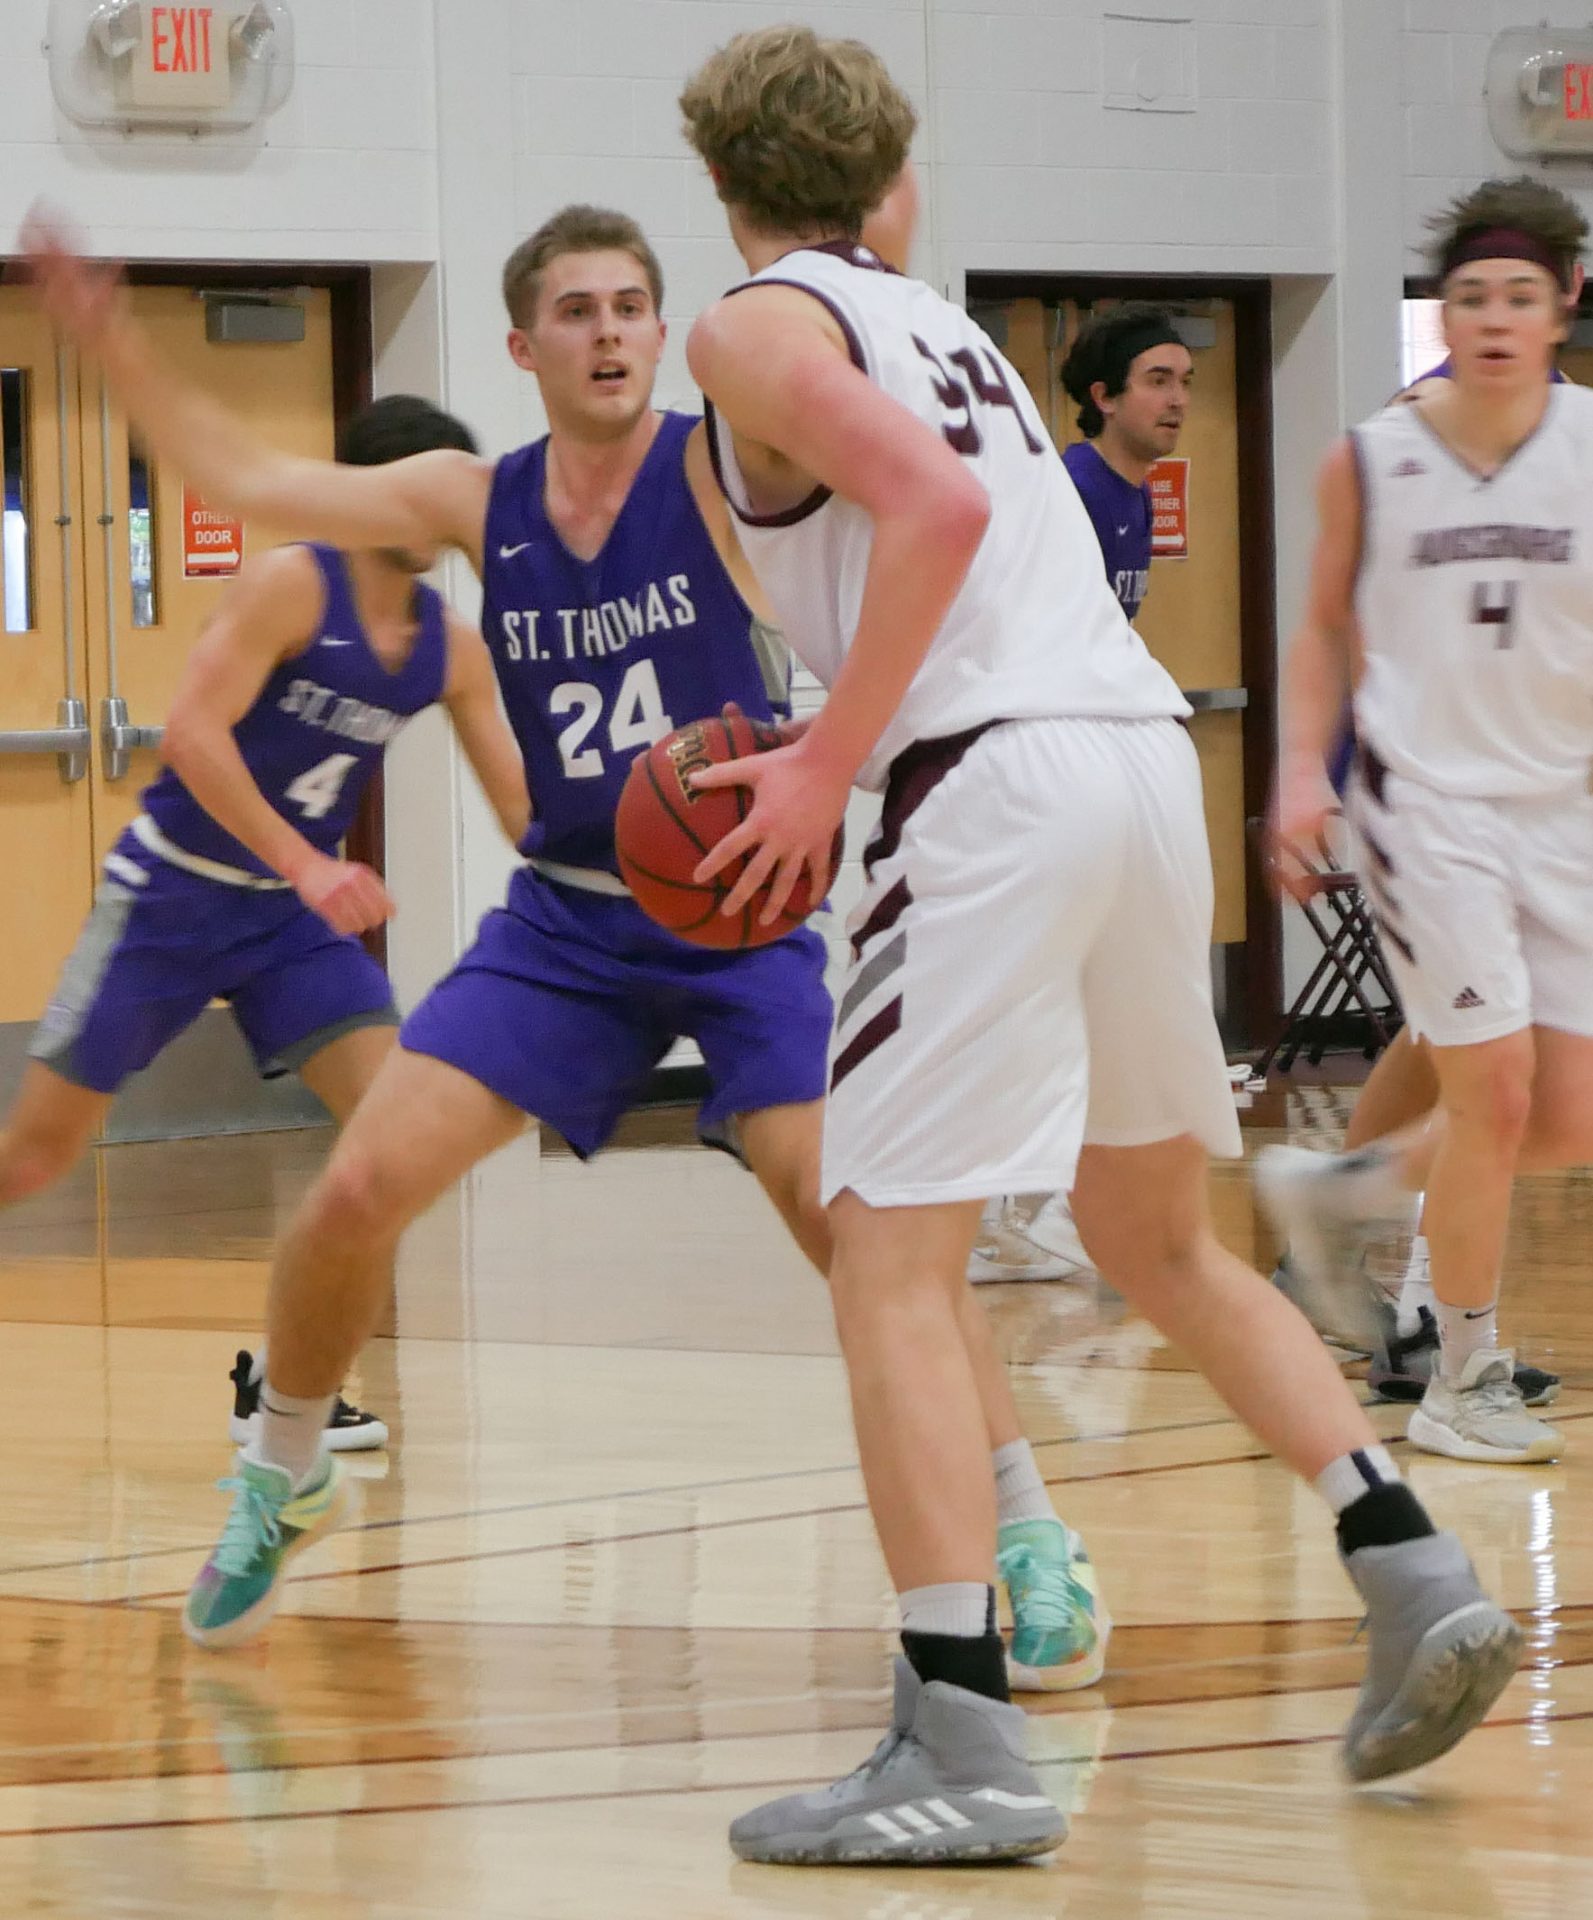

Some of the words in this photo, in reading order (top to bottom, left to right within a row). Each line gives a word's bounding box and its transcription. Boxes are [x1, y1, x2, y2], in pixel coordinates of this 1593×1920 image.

[152, 7, 212, 72] EXIT
[1152, 480, 1173, 493] USE
[195, 530, 232, 545] DOOR
[503, 611, 550, 661] ST.
[557, 574, 697, 659] THOMAS
[1470, 579, 1519, 650] 4
[550, 658, 674, 779] 24
[284, 753, 360, 819] 4
